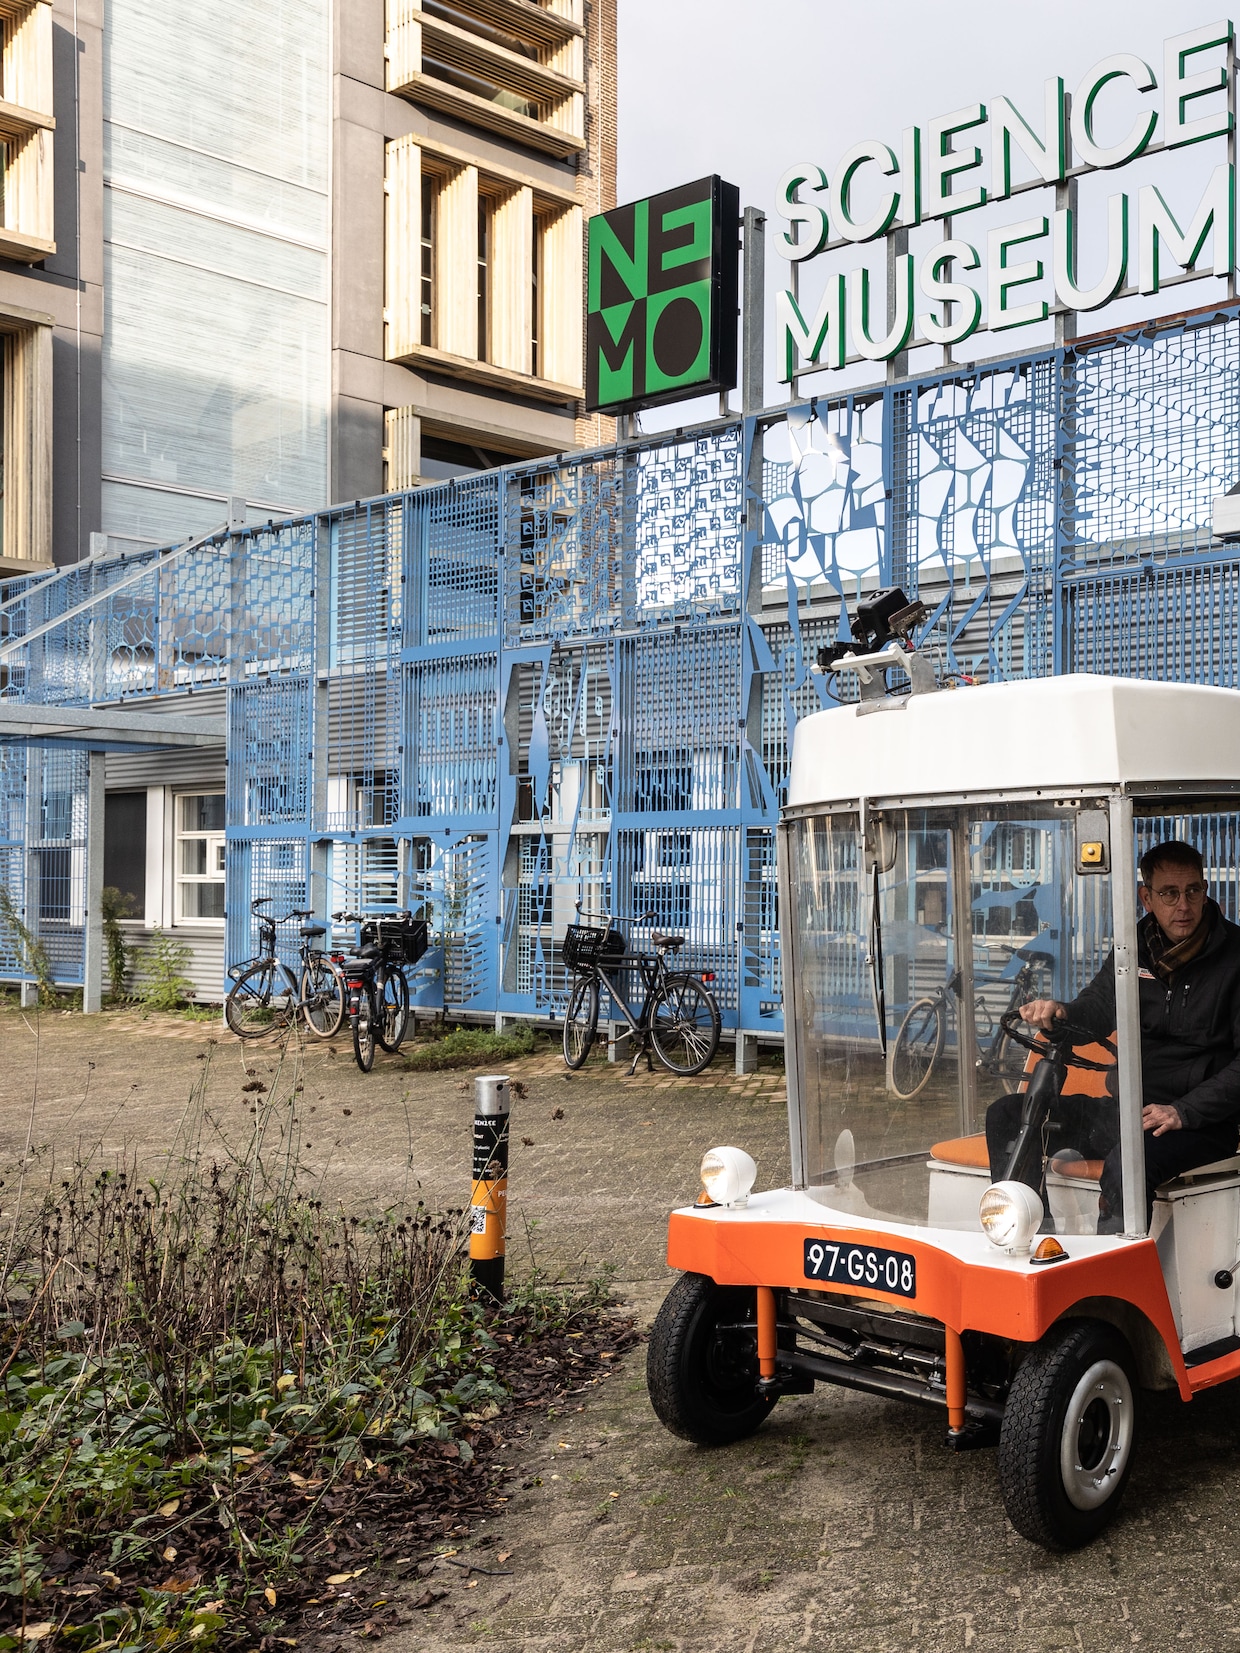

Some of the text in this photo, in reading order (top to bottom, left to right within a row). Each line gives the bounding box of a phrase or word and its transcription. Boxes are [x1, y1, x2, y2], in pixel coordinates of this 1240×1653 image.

[773, 19, 1234, 262] SCIENCE
[776, 163, 1234, 385] MUSEUM
[808, 1243, 913, 1292] 97-GS-08
